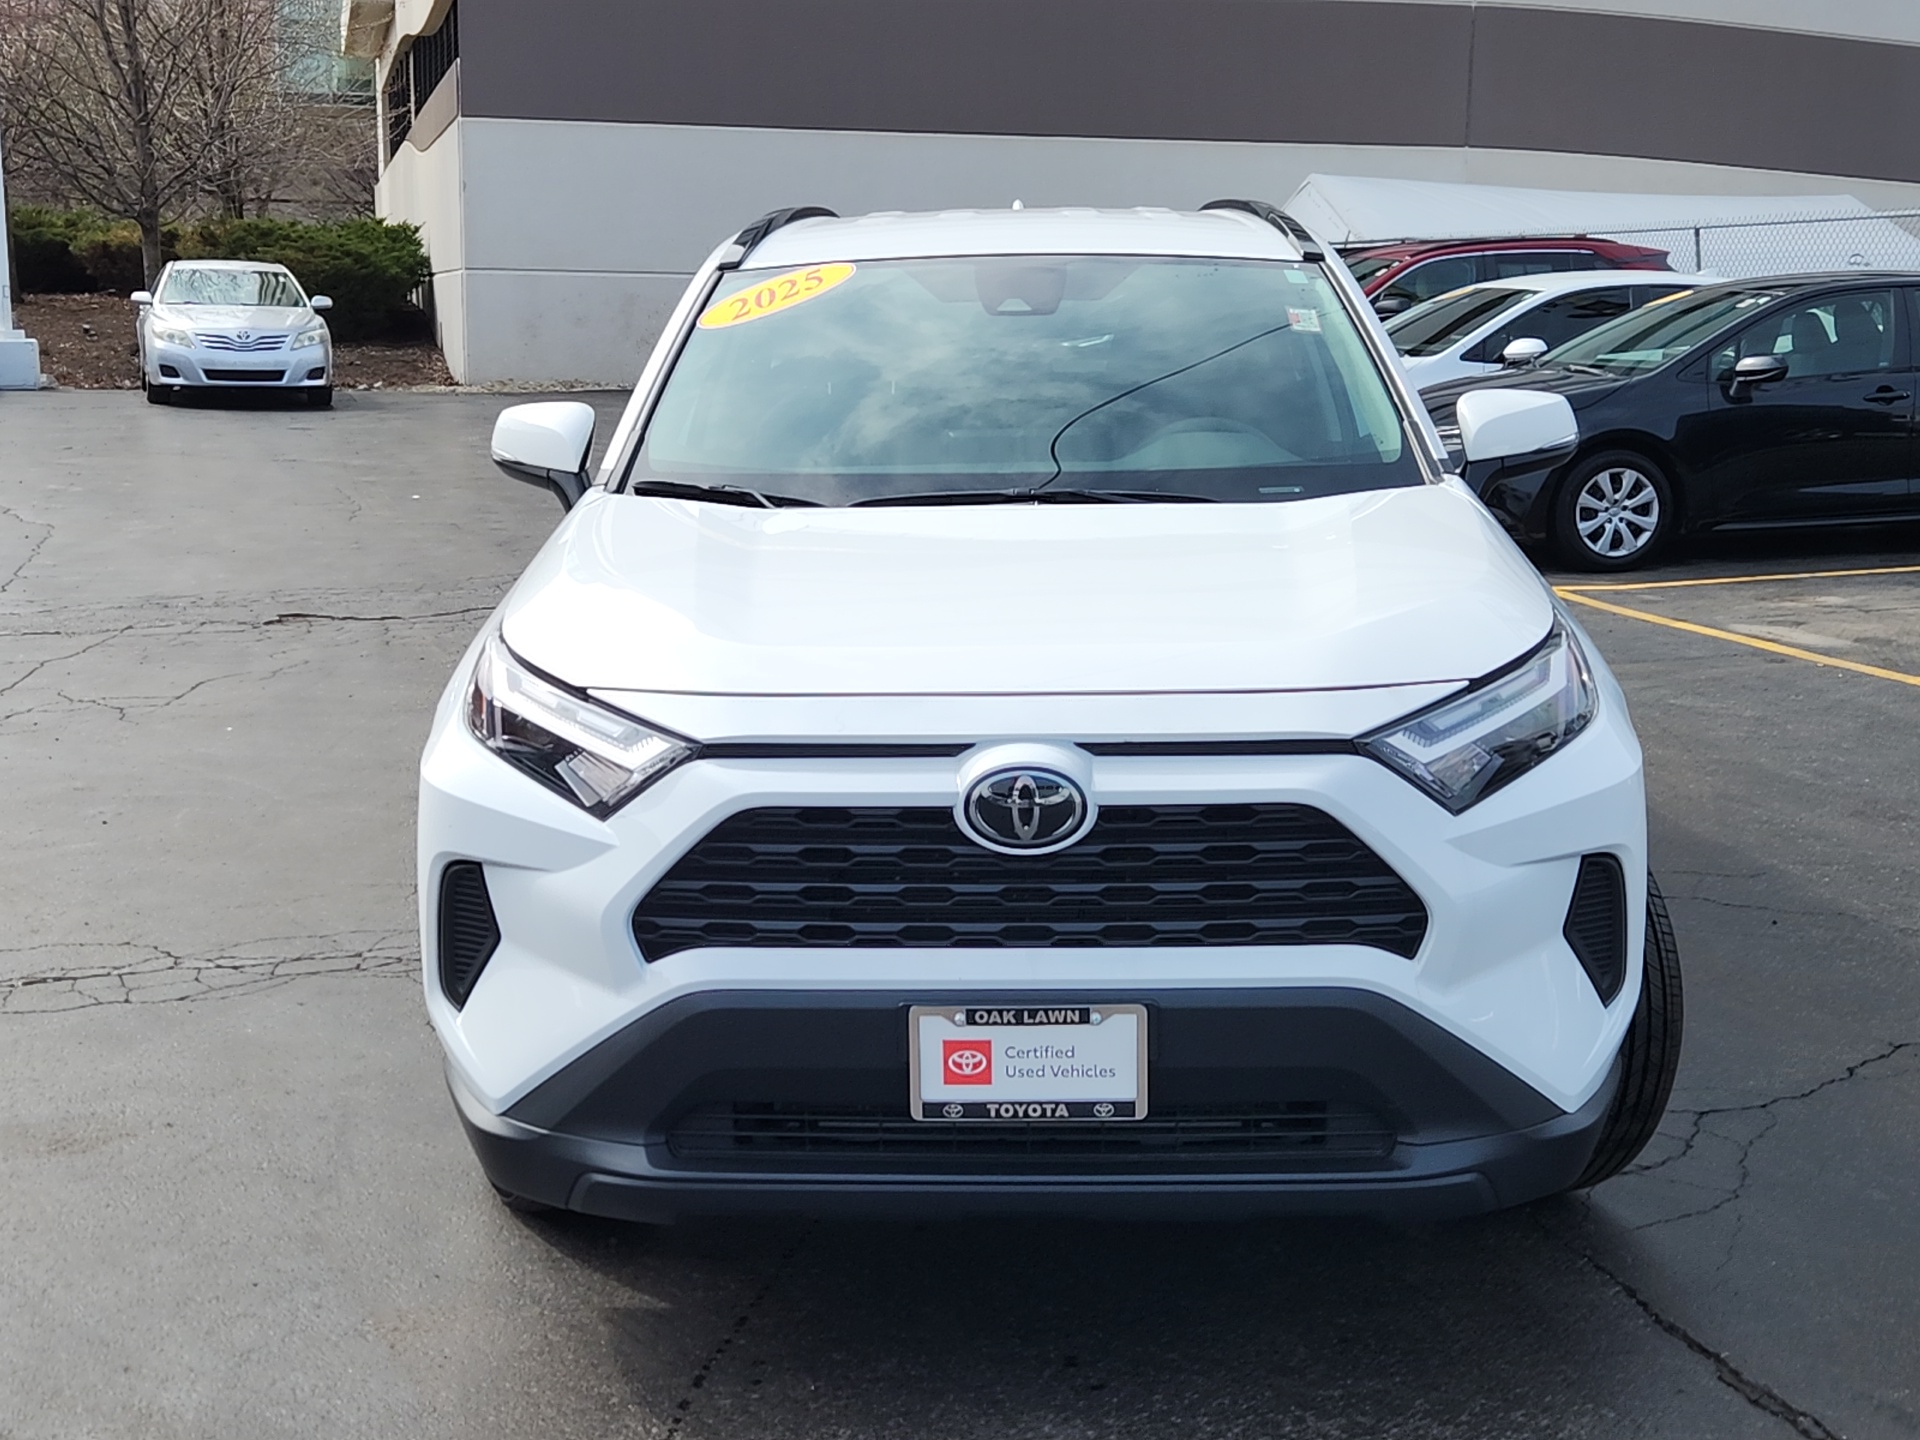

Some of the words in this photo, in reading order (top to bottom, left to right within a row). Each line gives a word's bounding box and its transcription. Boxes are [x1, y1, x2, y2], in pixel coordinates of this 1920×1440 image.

[729, 269, 824, 321] 2025
[974, 1010, 1017, 1024] OAK
[1023, 1009, 1080, 1024] LAWN
[1004, 1046, 1076, 1059] Certified
[1005, 1065, 1046, 1078] Used
[1050, 1065, 1116, 1078] Vehicles
[986, 1103, 1070, 1118] TOYOTA
